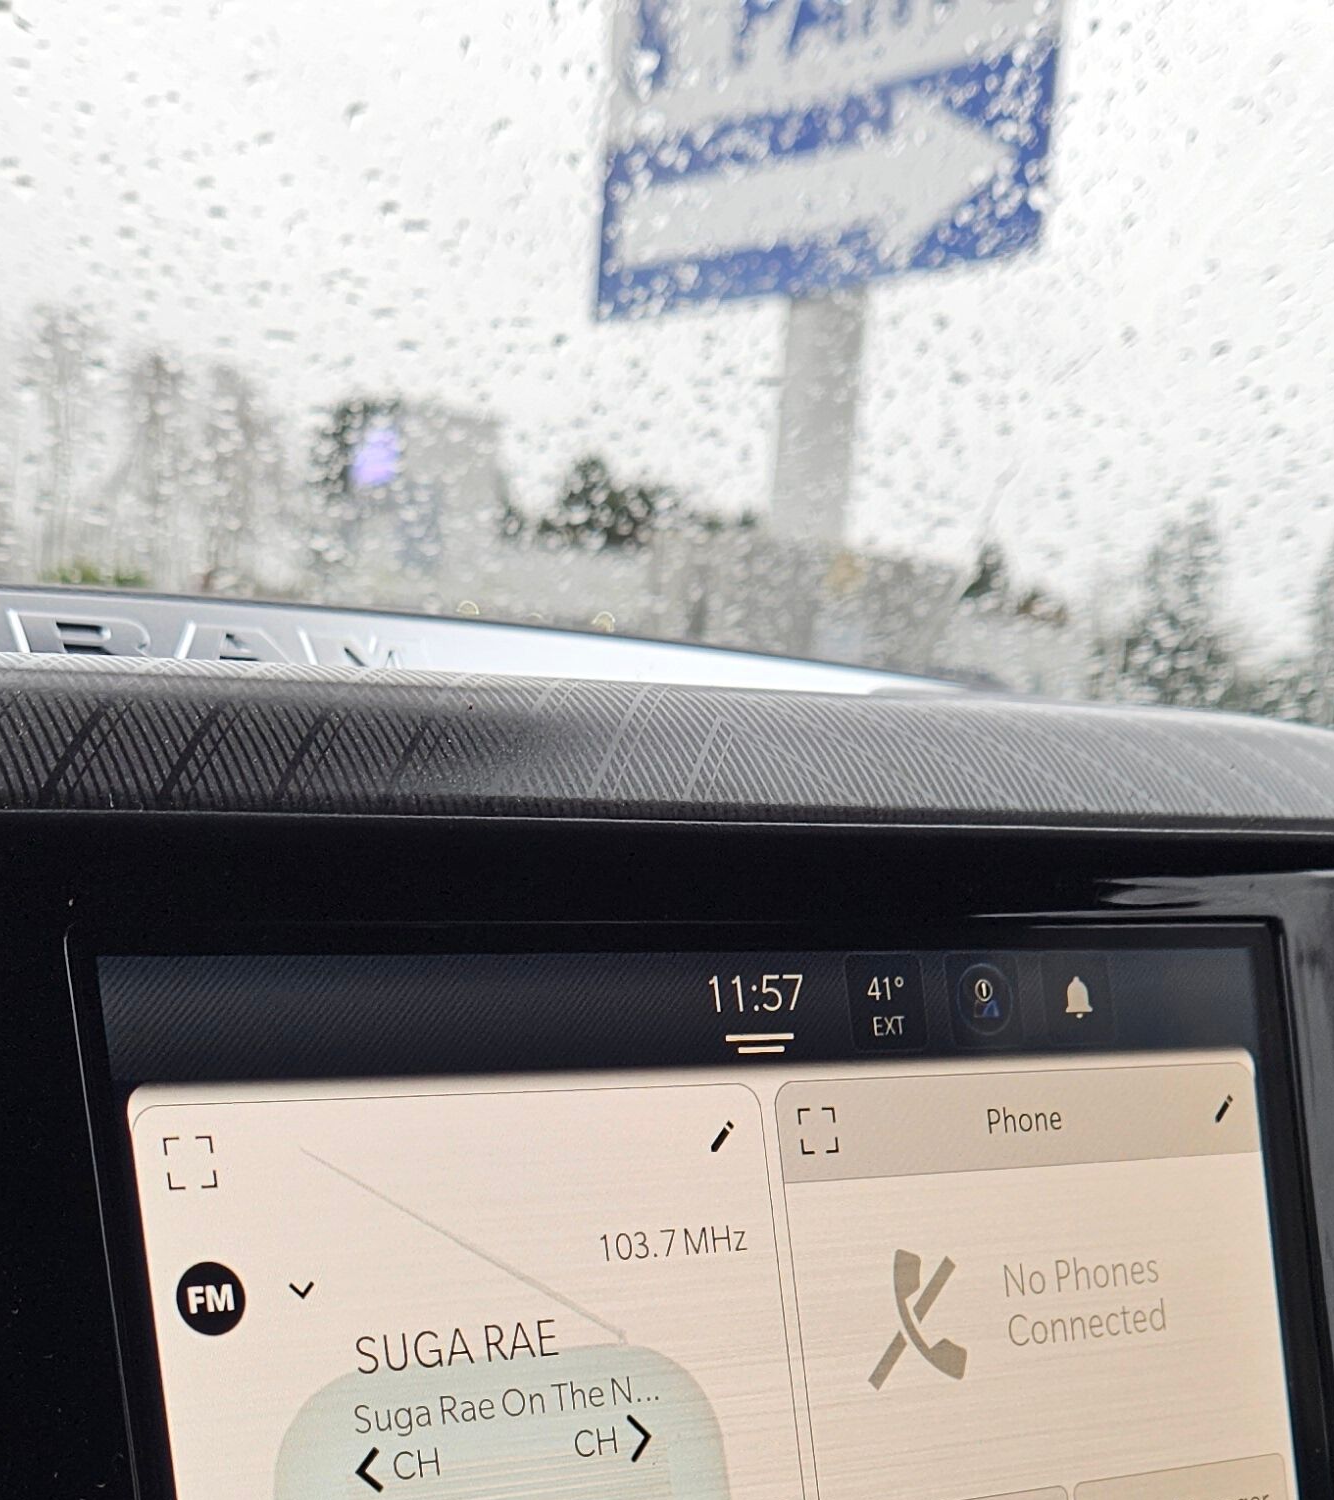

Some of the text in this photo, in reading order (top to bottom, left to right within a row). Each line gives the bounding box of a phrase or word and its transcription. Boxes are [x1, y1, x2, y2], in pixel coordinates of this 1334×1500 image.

[707, 973, 805, 1013] 11:57
[872, 1015, 905, 1036] EXT
[986, 1106, 1063, 1136] Phone
[599, 1226, 748, 1262] 103.7 MHz
[1003, 1255, 1160, 1298] No Phones
[186, 1284, 236, 1314] FM
[1007, 1299, 1167, 1347] Connected
[355, 1319, 561, 1374] SUGA RAE
[354, 1404, 433, 1436] Suga
[440, 1394, 495, 1424] Rae
[501, 1388, 545, 1416] On
[552, 1380, 605, 1409] The
[574, 1427, 617, 1458] CH
[392, 1448, 441, 1480] CH
